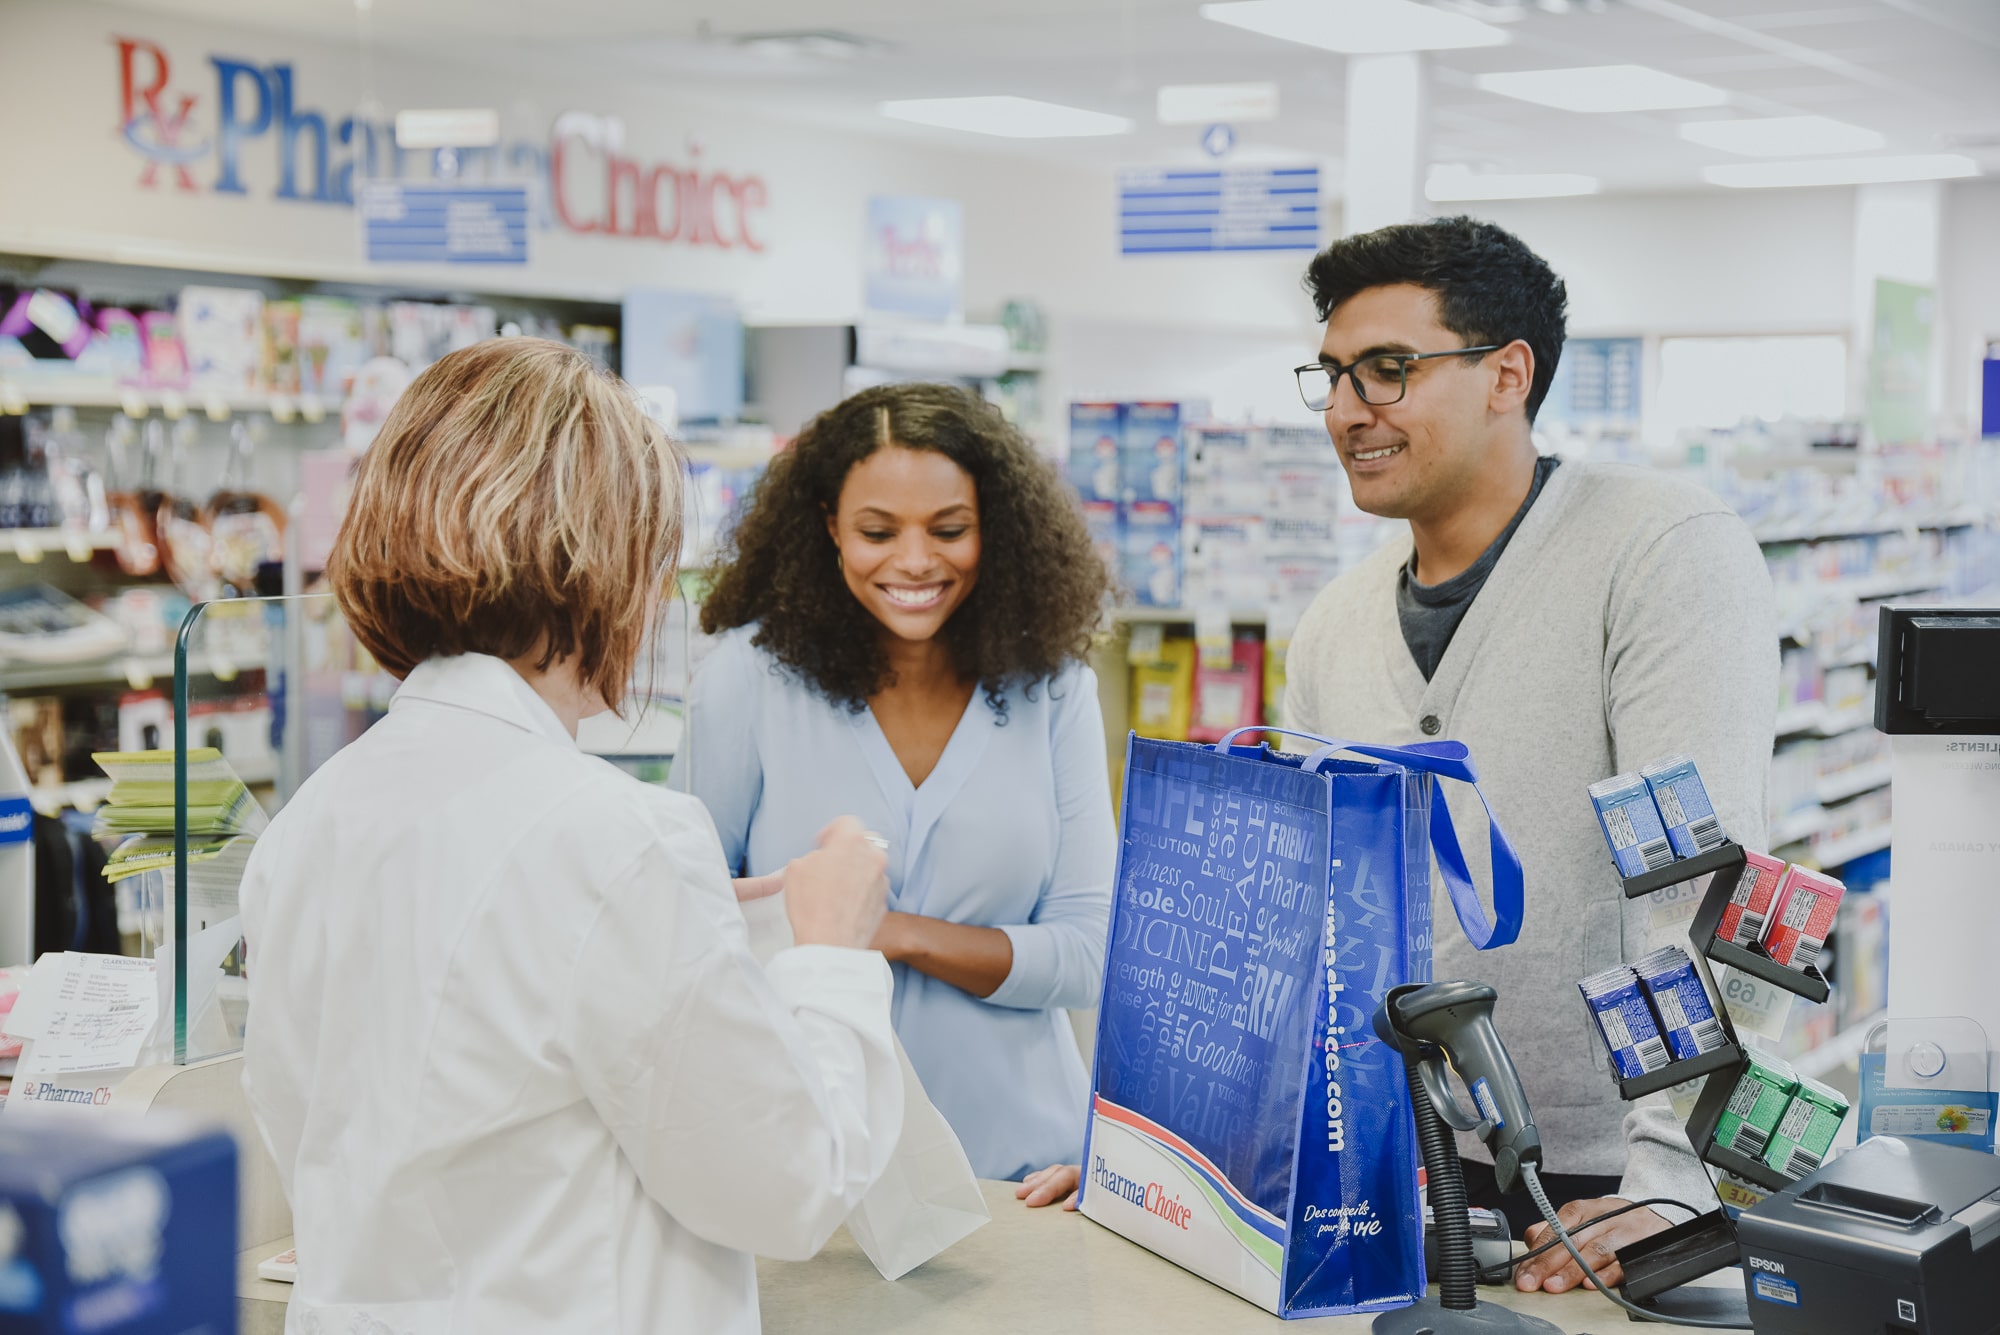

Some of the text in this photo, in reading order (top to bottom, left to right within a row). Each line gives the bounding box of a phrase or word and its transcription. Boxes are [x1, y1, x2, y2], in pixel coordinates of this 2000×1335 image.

[1131, 754, 1209, 837] LIFE
[1130, 827, 1202, 859] SOLUTION
[1206, 800, 1268, 988] PEACE
[1215, 864, 1236, 883] PILLS
[1176, 880, 1230, 930] Soul
[1231, 906, 1270, 1031] Bottle
[1180, 977, 1234, 1026] ADVICE for
[1132, 992, 1161, 1074] BODY
[1141, 970, 1183, 1114] Complete
[1170, 1012, 1189, 1059] Life
[1217, 1083, 1248, 1109] VIGOR
[1094, 1154, 1193, 1231] PharmaChoice
[1303, 1199, 1371, 1223] Des conseils
[1353, 1211, 1384, 1237] vie
[1749, 1255, 1785, 1275] EPSON
